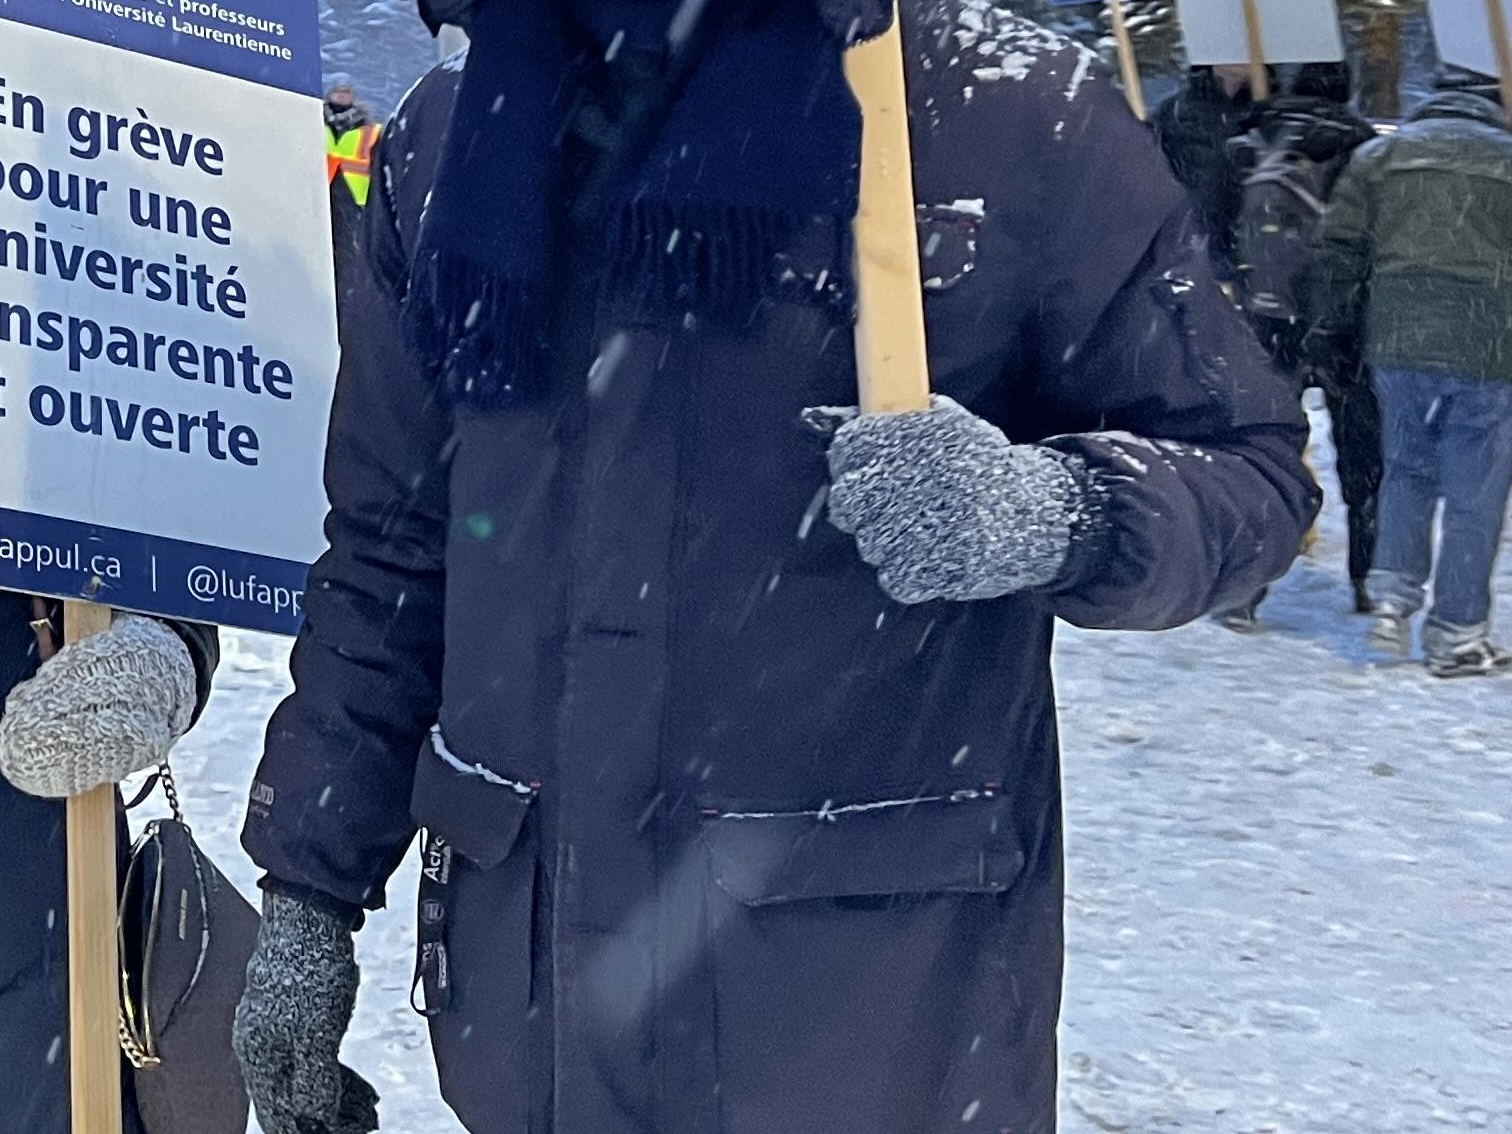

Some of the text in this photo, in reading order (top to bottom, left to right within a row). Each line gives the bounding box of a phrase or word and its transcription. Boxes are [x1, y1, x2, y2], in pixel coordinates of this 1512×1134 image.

[172, 15, 293, 61] Laurentienne
[67, 106, 224, 176] grève
[129, 186, 232, 246] une
[29, 384, 260, 467] ouverte
